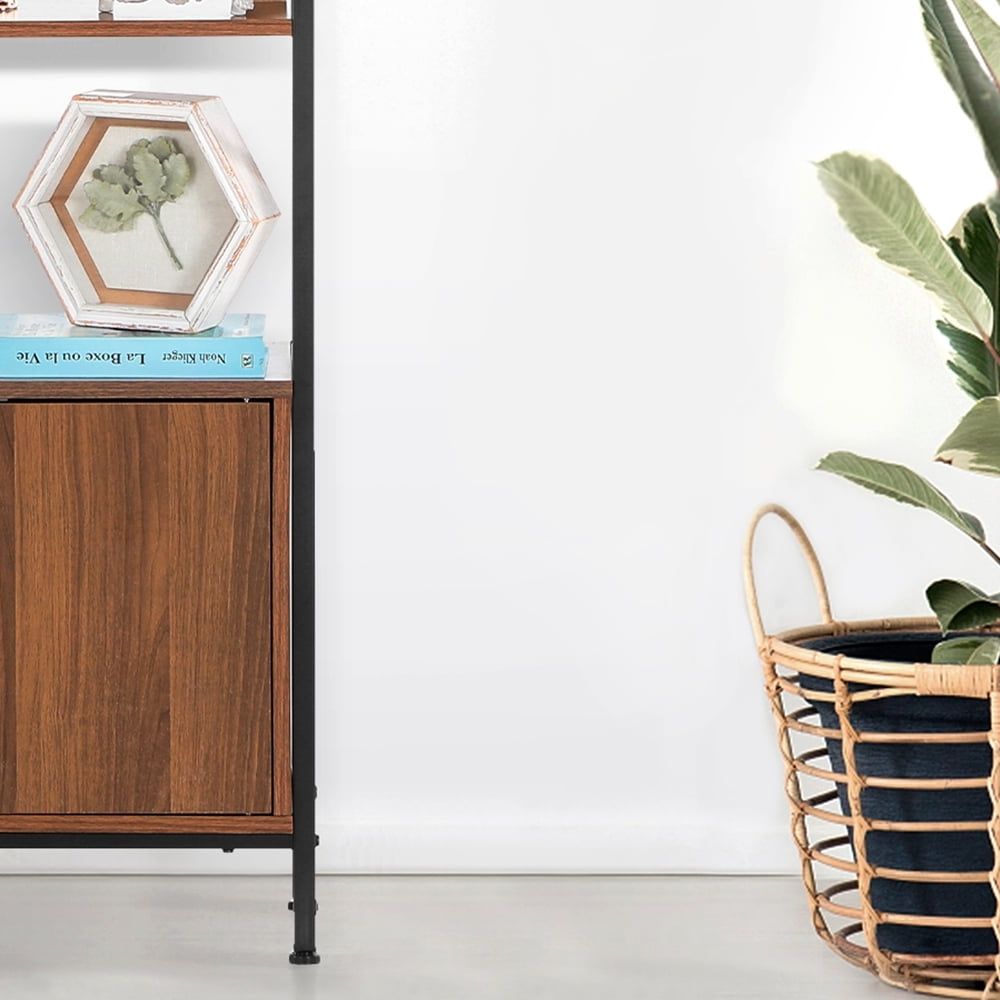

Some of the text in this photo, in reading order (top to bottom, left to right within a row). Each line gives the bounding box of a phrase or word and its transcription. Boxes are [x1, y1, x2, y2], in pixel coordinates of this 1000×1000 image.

[16, 352, 146, 365] La Boxe ou la Vie
[162, 350, 226, 365] Noah Klieger
